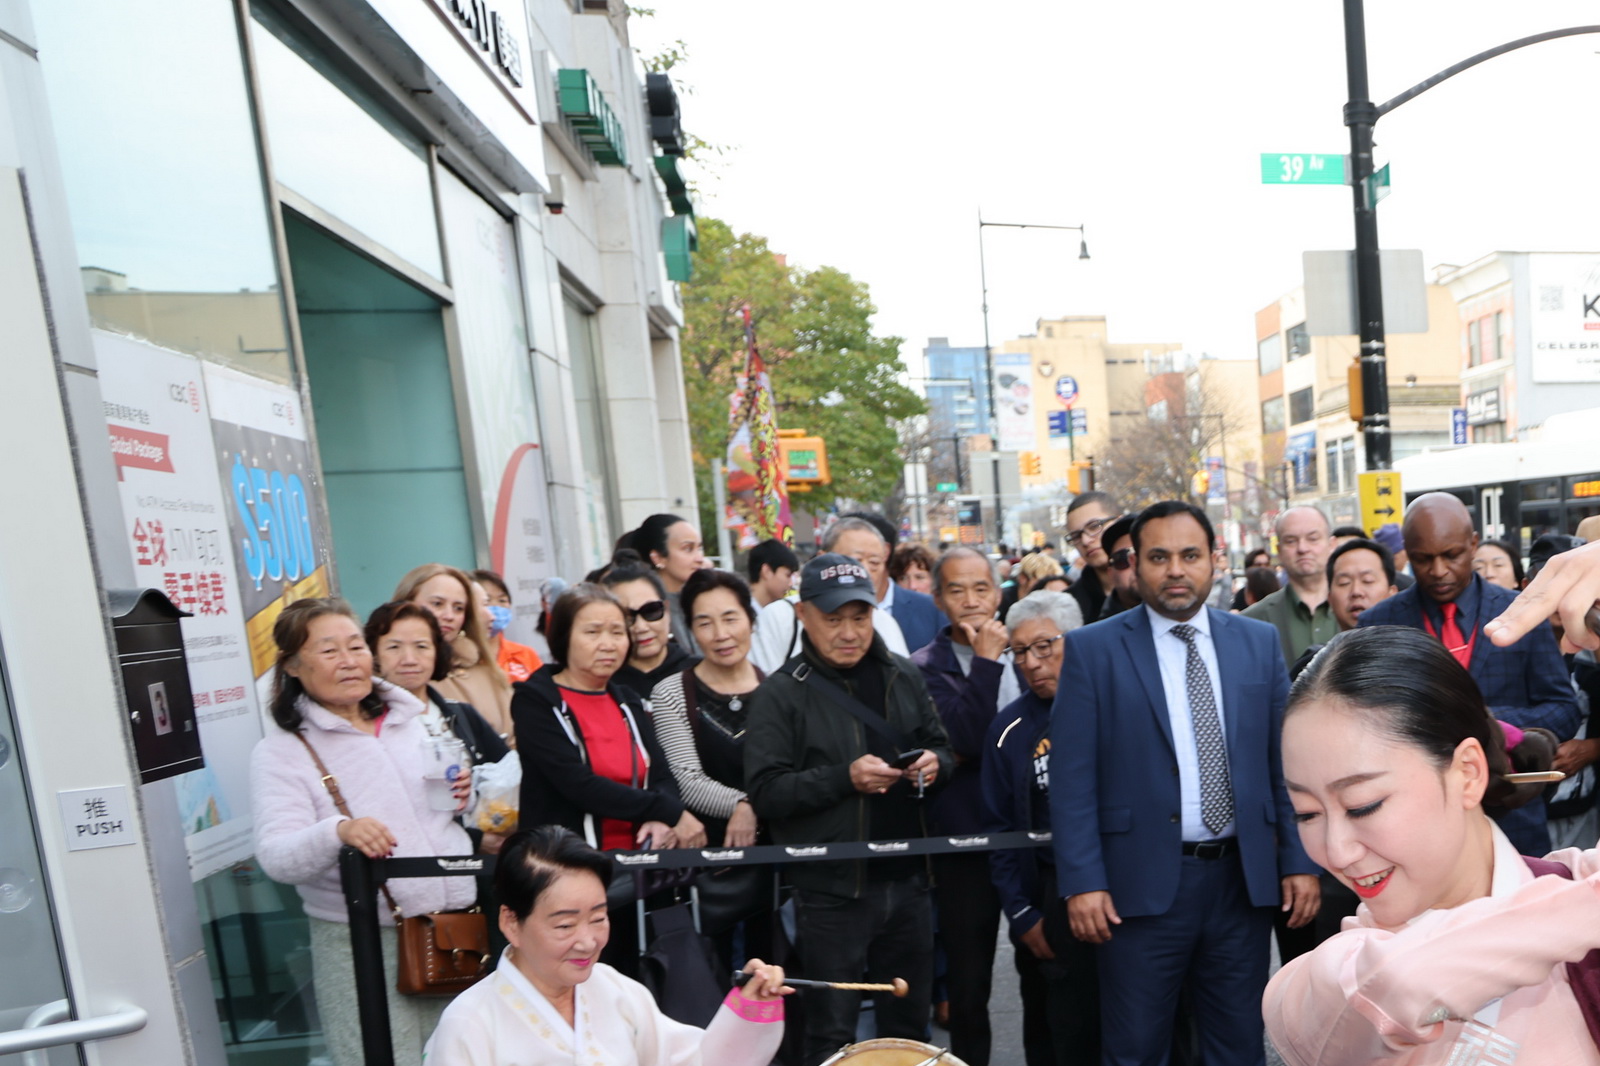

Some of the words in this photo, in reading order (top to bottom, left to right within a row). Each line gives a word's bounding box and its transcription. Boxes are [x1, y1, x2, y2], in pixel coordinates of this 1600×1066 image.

[1279, 155, 1304, 182] 39
[1309, 154, 1325, 171] Av
[232, 453, 314, 592] $500
[820, 566, 837, 581] US
[837, 563, 868, 579] OPEN
[83, 797, 109, 820] 推
[75, 820, 123, 838] PUSH
